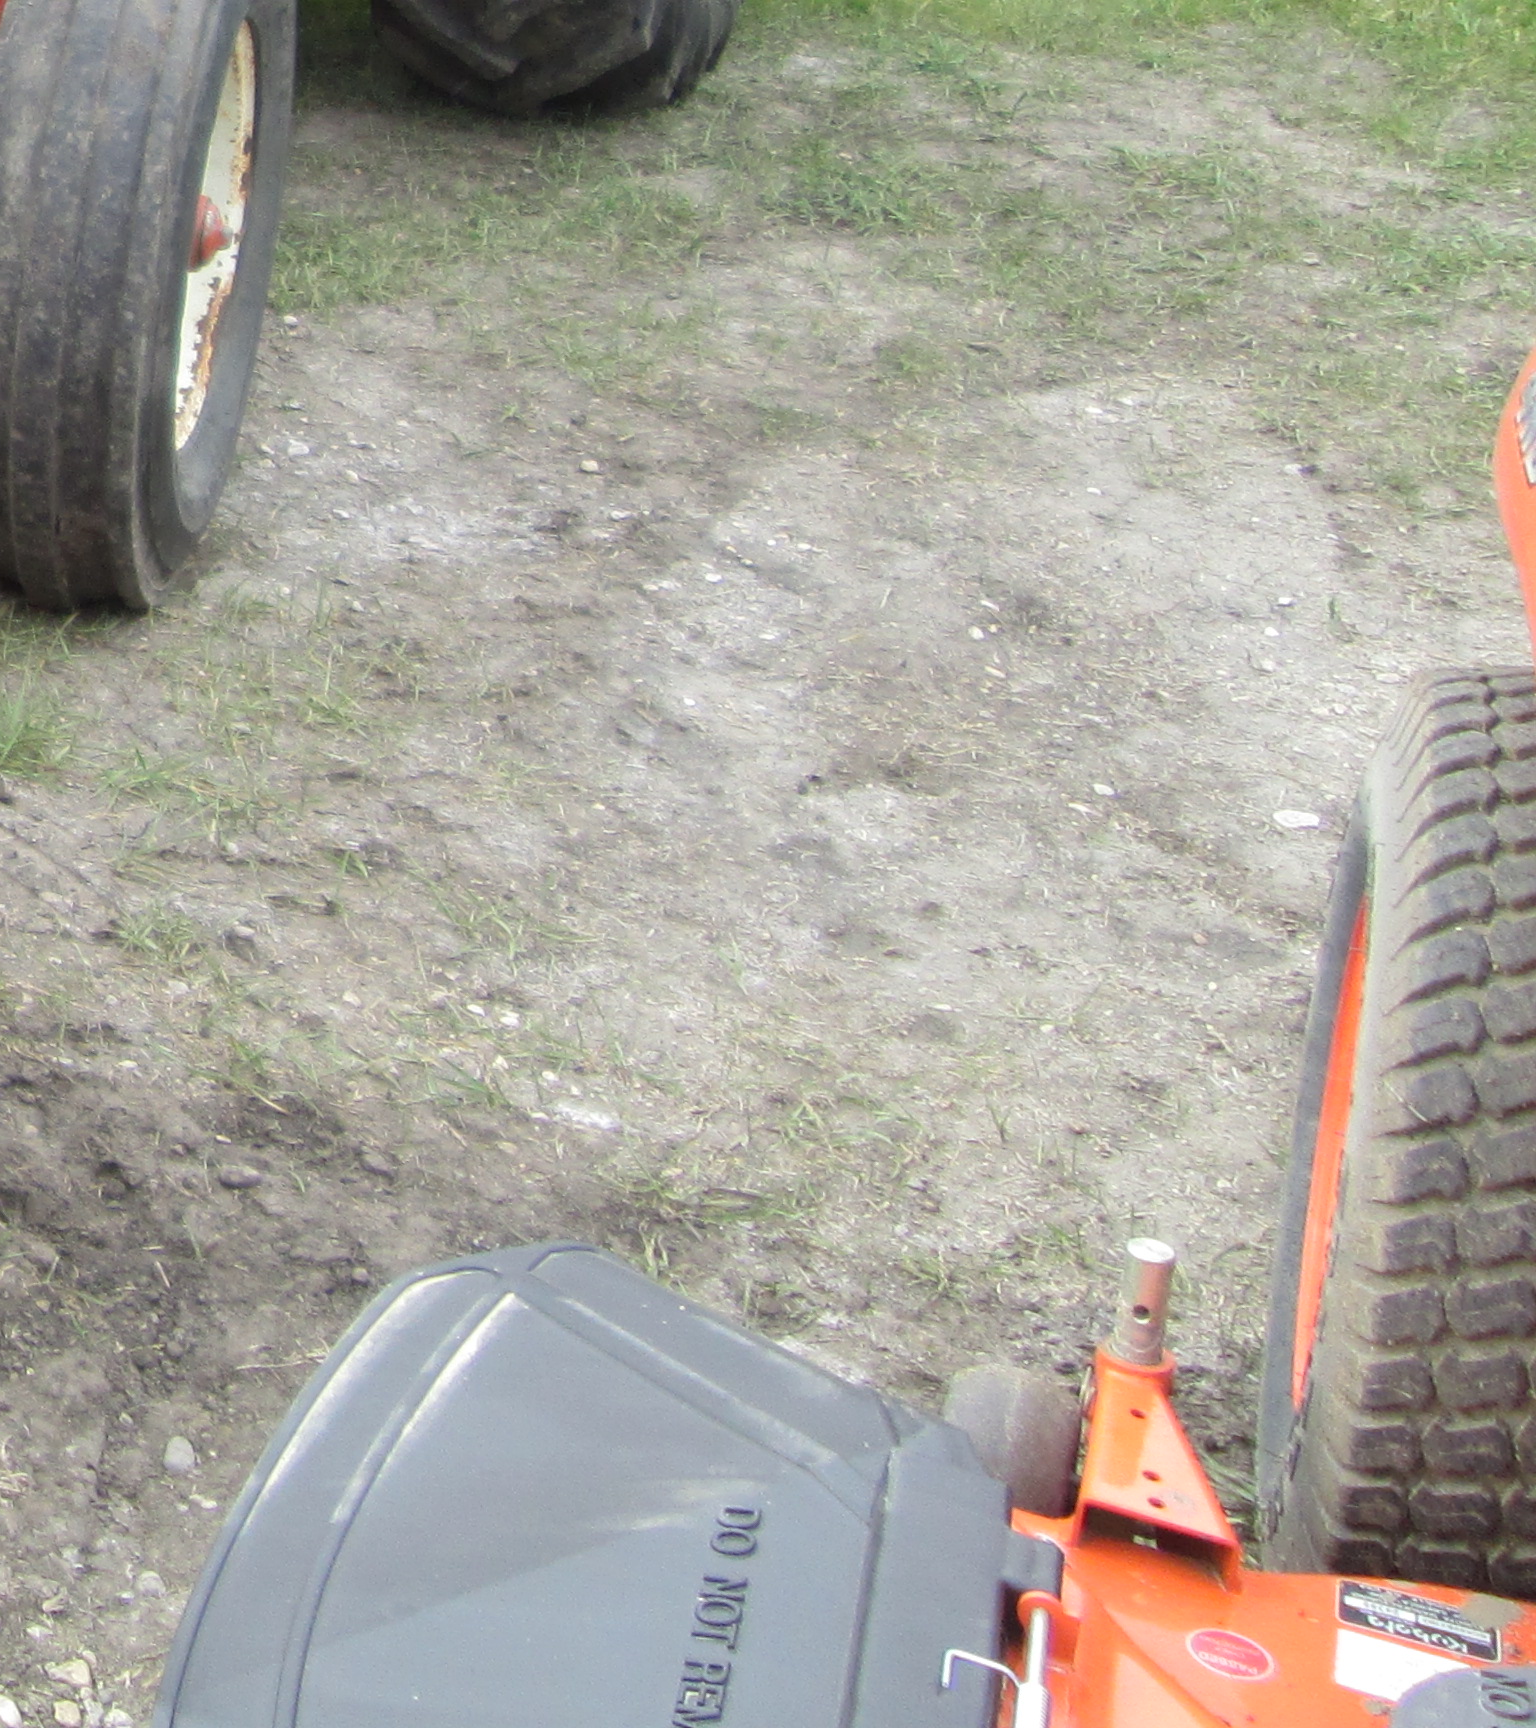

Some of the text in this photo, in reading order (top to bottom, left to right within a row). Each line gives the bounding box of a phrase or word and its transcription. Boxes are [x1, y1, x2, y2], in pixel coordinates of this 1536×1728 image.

[710, 1506, 763, 1557] DO
[690, 1575, 749, 1651] NOT
[1366, 1615, 1469, 1656] Kubota
